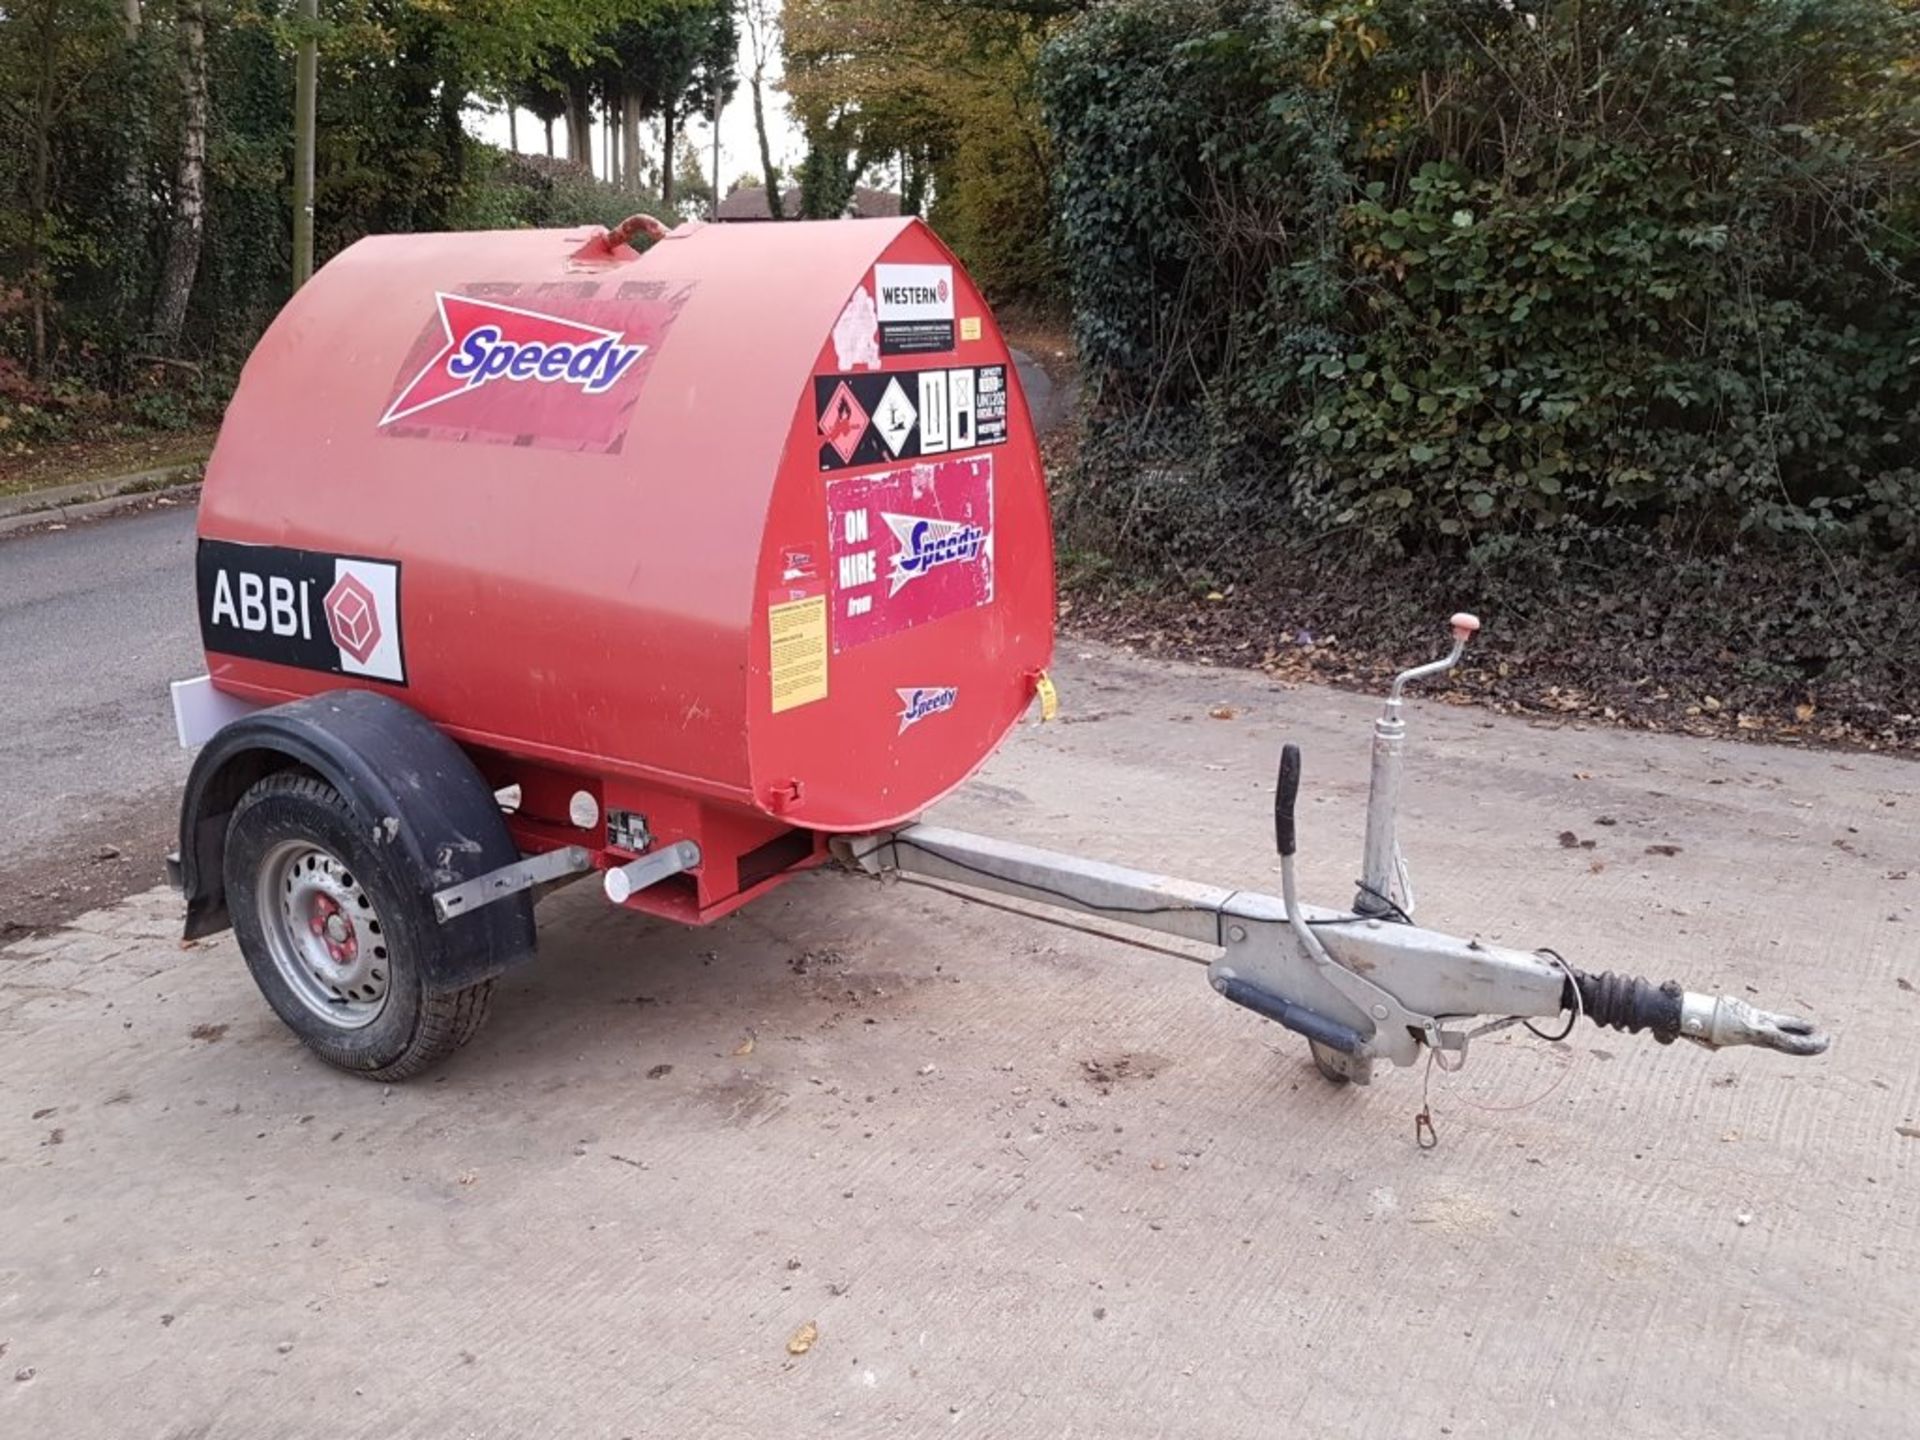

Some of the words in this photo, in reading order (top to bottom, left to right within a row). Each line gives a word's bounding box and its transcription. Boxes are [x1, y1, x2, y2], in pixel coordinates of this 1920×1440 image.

[882, 286, 937, 305] WESTERN
[449, 325, 645, 392] Speedy
[844, 507, 869, 545] ON
[899, 519, 983, 573] Speedy
[838, 549, 877, 590] HIRE
[211, 568, 312, 641] ABBI
[904, 689, 956, 720] Speedy
